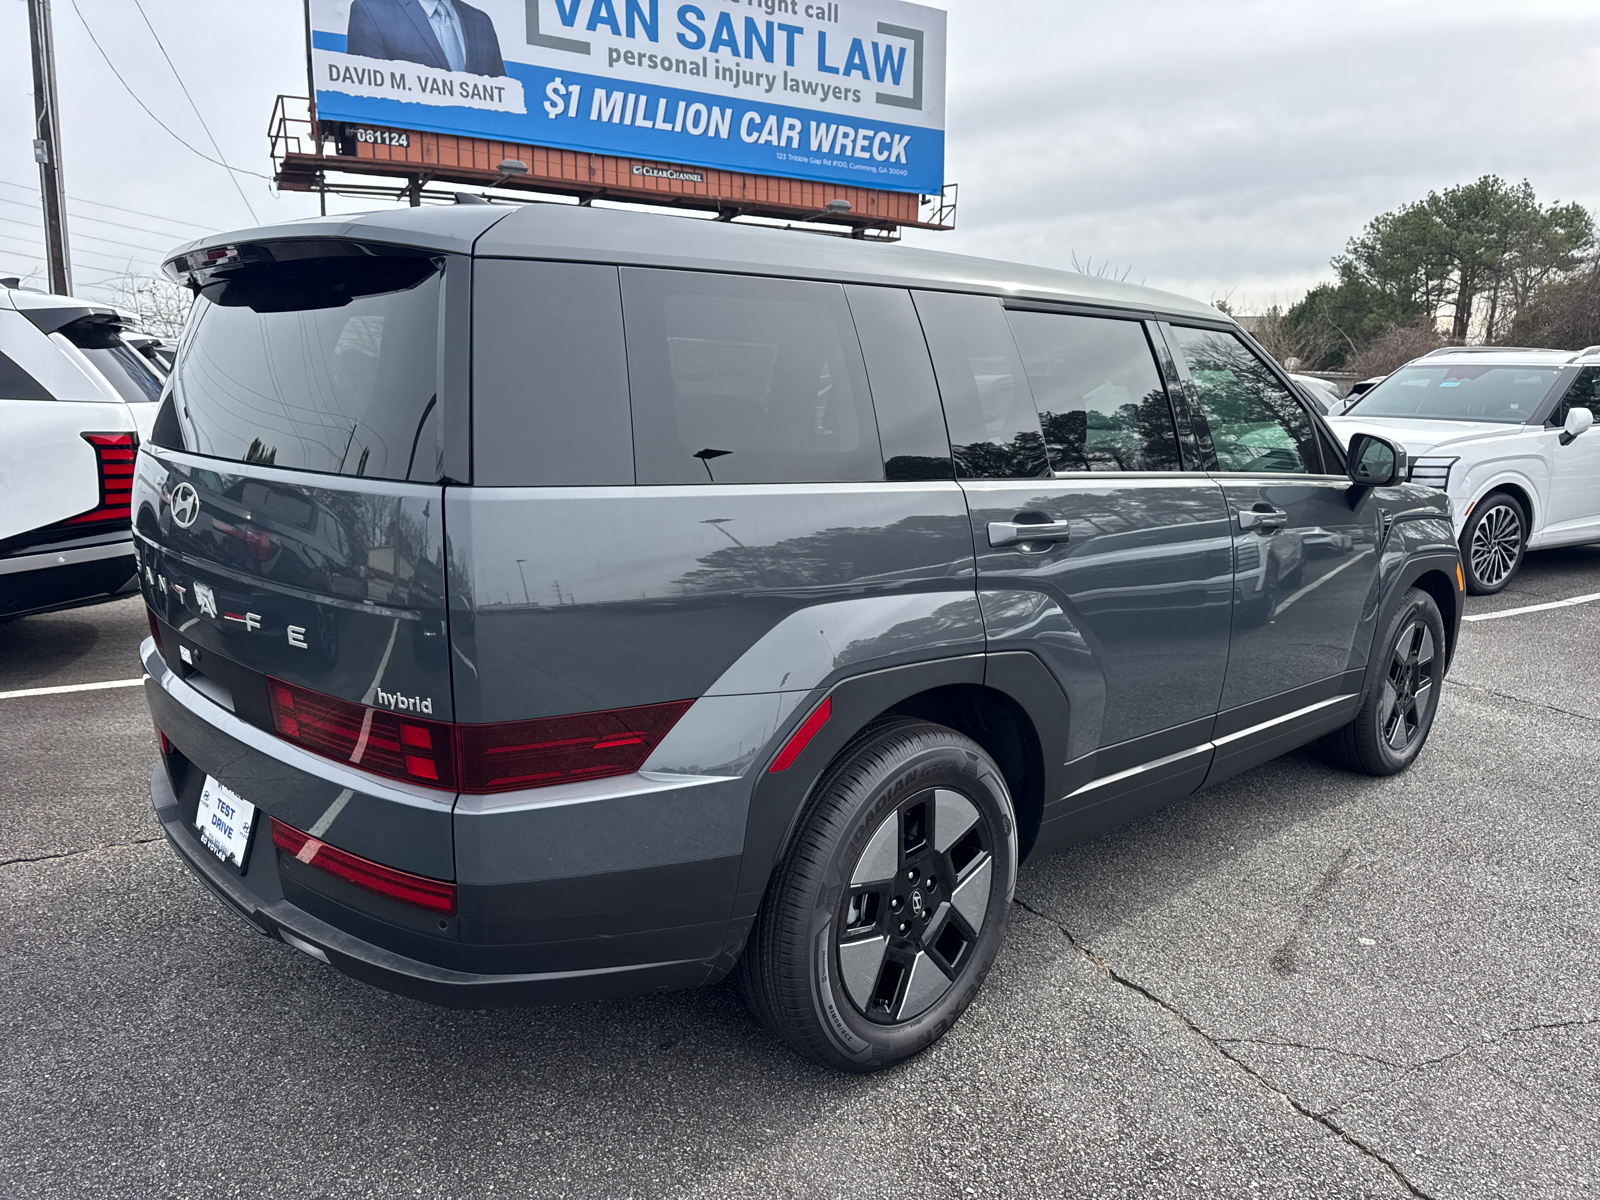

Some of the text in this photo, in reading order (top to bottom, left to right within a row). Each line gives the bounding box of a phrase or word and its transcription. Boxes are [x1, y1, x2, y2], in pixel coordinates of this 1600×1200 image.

[804, 2, 838, 23] call
[554, 0, 907, 86] VAN SANT LAW
[328, 63, 505, 103] DAVID M. VAN SANT
[608, 46, 861, 103] personal injury lawyers
[543, 77, 911, 164] $1 MILLION CAR WRECK
[356, 128, 408, 147] 061124
[776, 152, 787, 161] 123
[788, 154, 808, 163] Tribble
[809, 157, 822, 166] Gap
[849, 163, 878, 174] Cumming,
[888, 168, 908, 176] 30040
[245, 612, 308, 650] FE
[377, 687, 433, 715] hybrid
[217, 797, 235, 820] TEST
[211, 813, 234, 840] DRIVE
